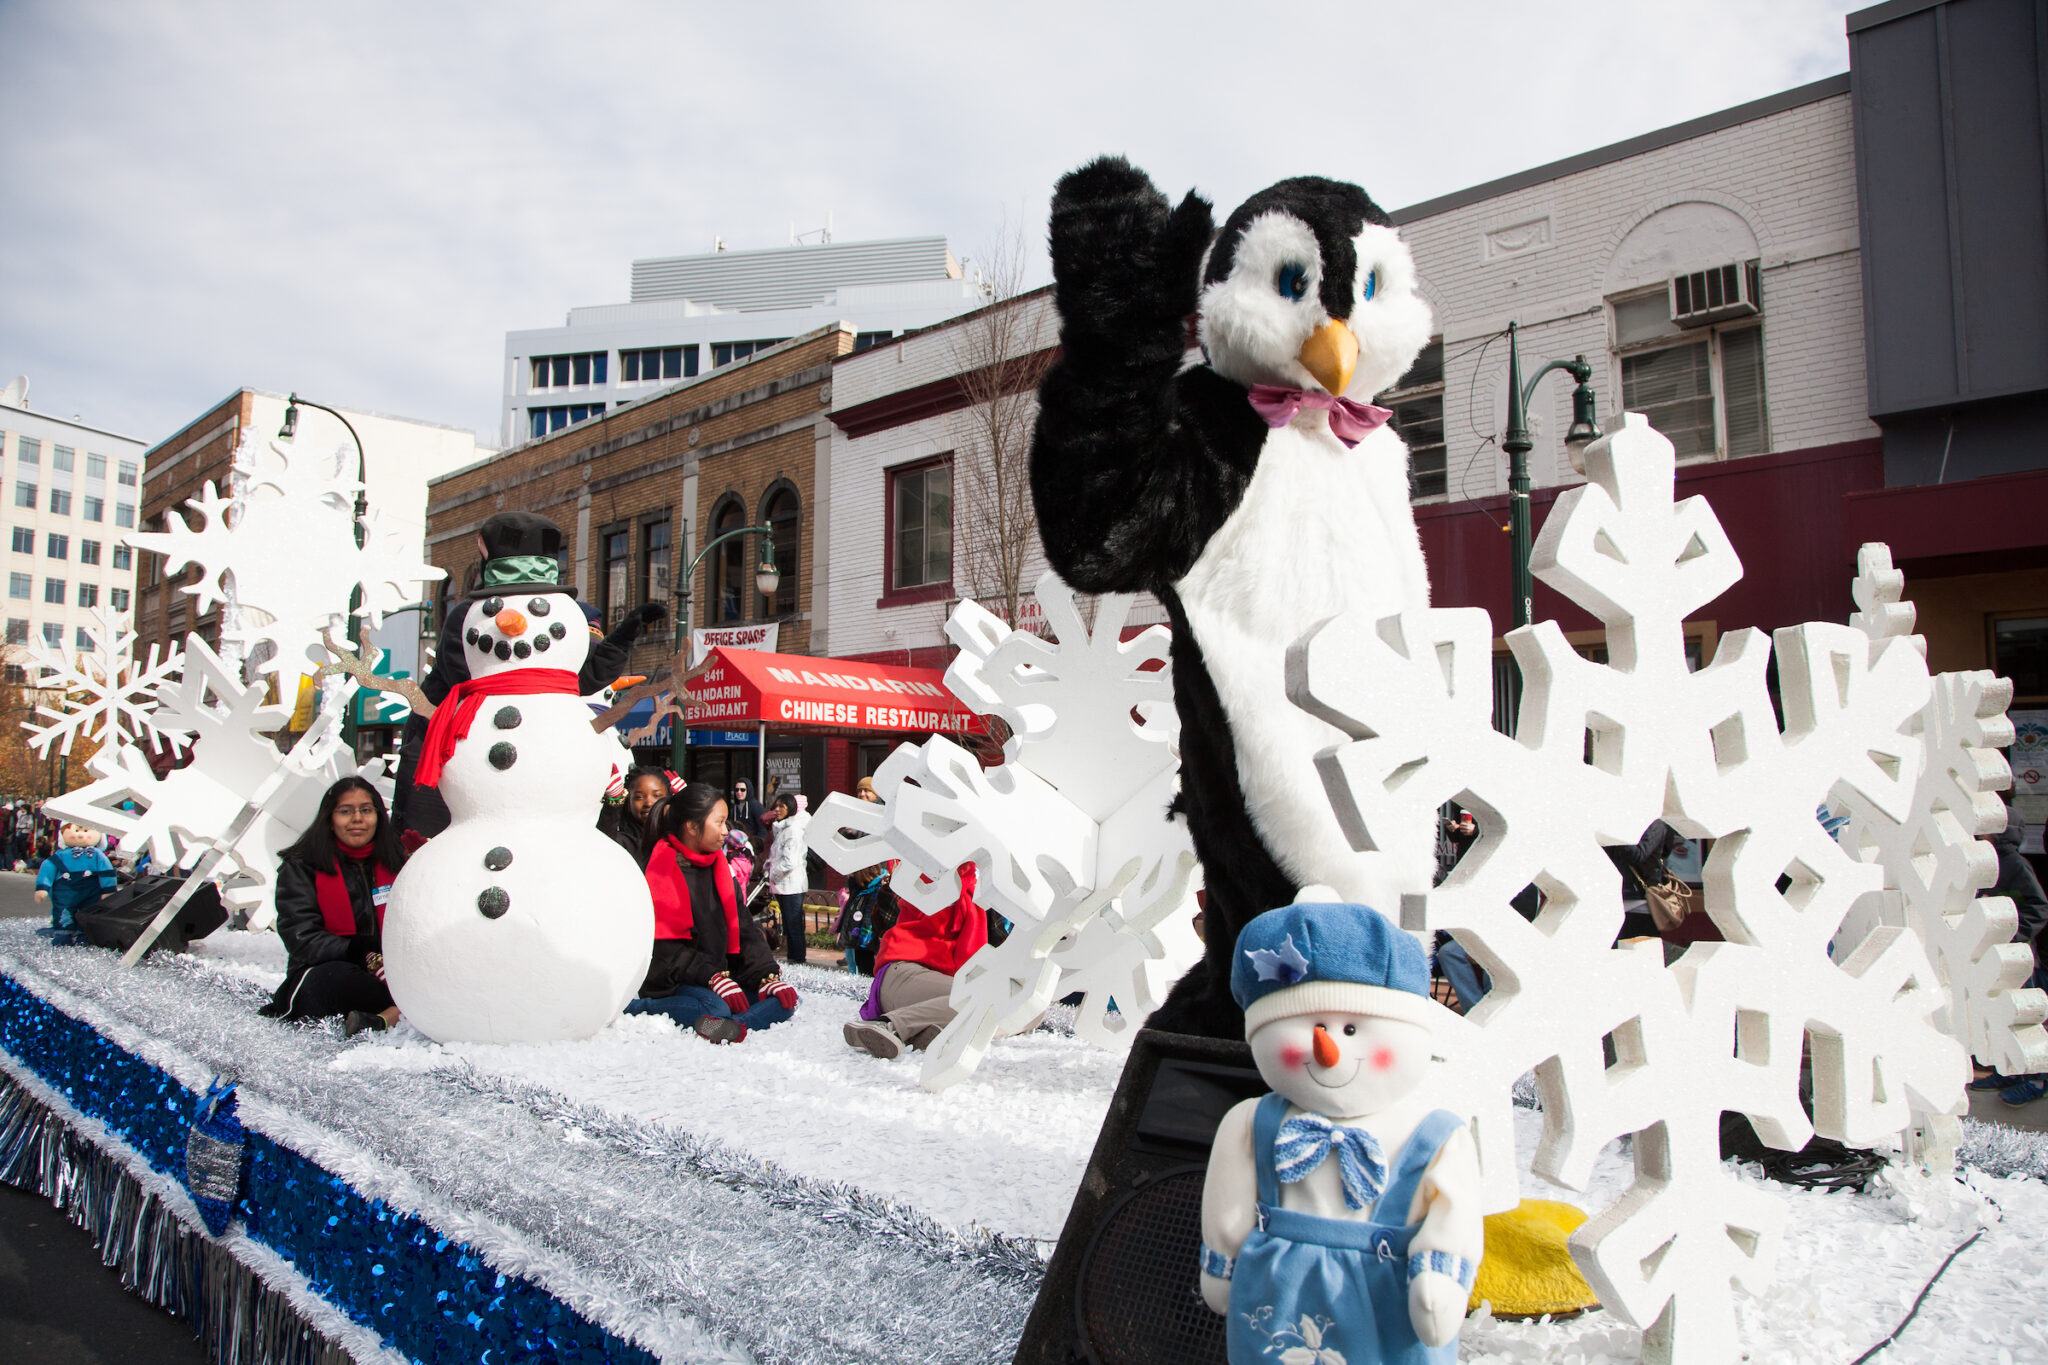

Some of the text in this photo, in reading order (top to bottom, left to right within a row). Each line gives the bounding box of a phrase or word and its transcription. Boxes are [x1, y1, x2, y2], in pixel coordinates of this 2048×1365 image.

[704, 629, 767, 646] OFFICE SPACE
[704, 668, 724, 683] 8411
[766, 667, 945, 697] MANDARIN
[684, 702, 748, 720] ESTAURANT
[780, 699, 971, 731] CHINESE RESTAURANT
[766, 757, 802, 769] SWAY HAIR
